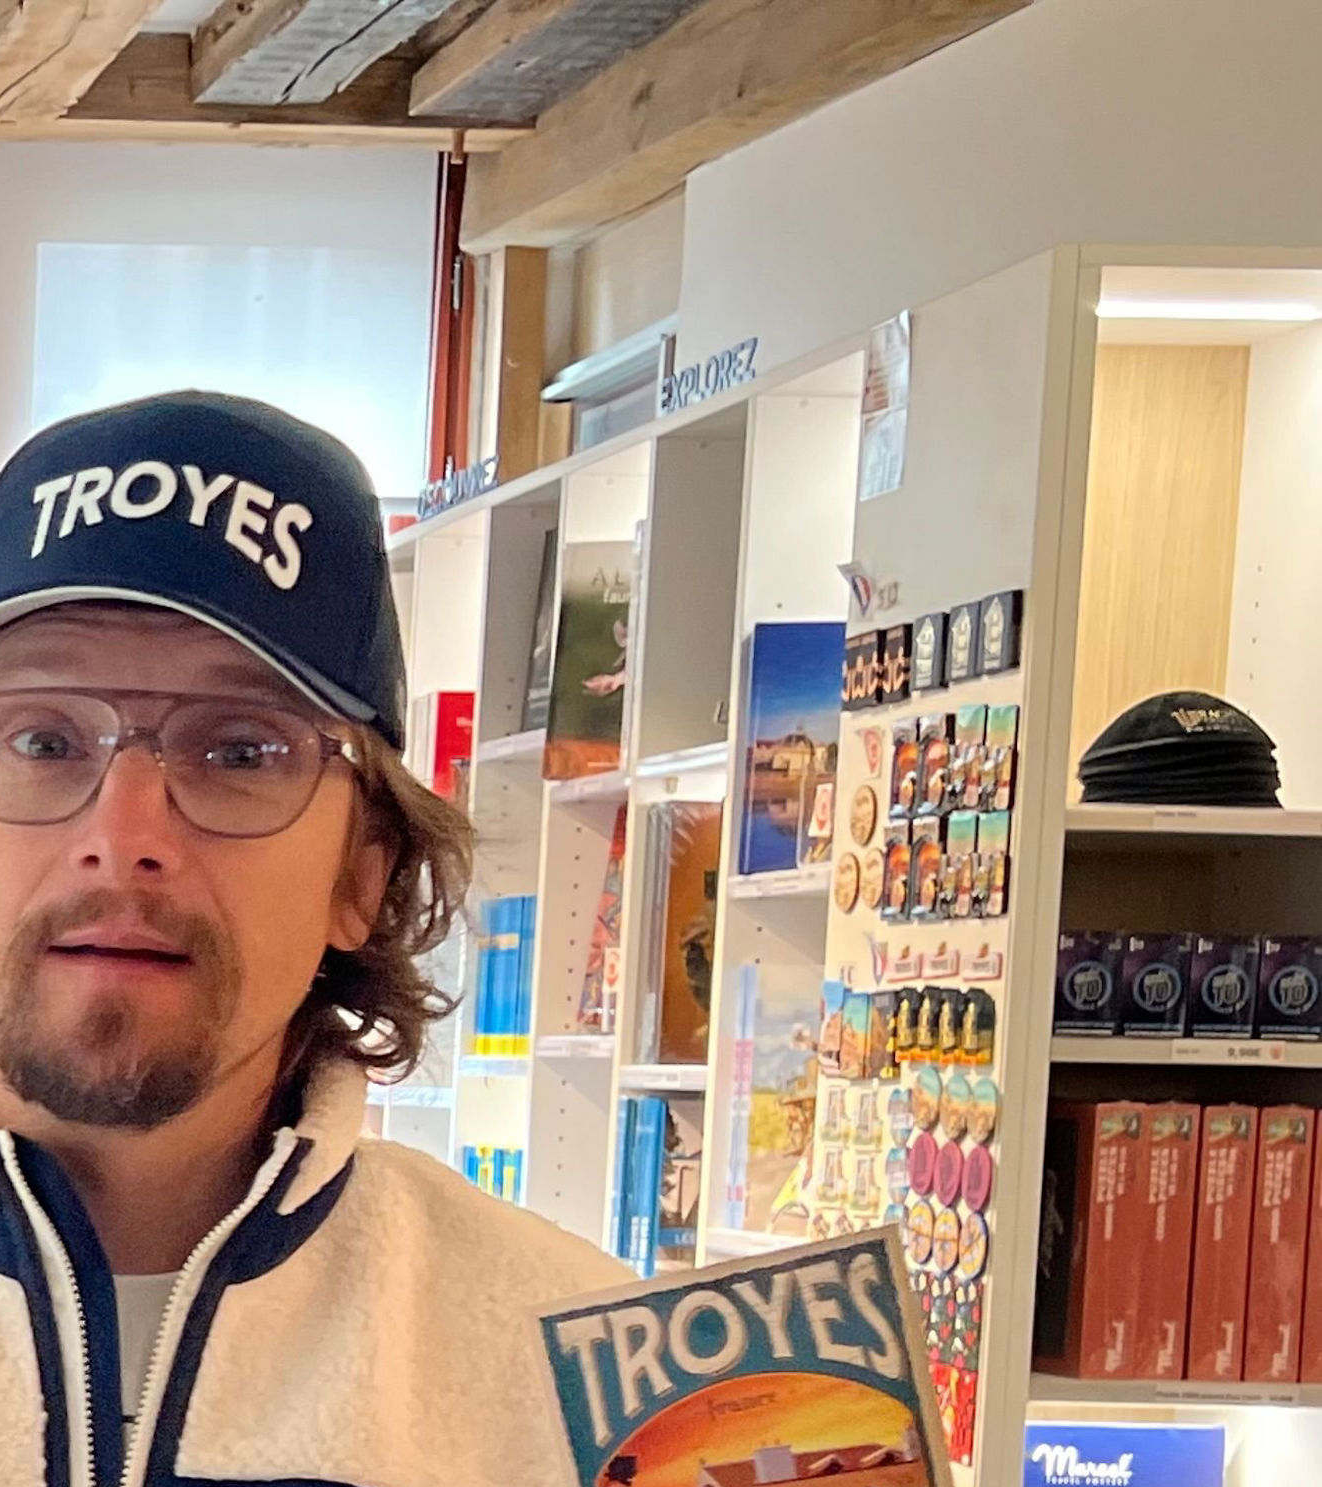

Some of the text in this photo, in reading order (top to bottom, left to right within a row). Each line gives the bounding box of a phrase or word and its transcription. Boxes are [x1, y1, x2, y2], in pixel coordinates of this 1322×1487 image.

[661, 337, 758, 413] EXPLOREZ
[30, 460, 313, 590] TROYES
[557, 1253, 906, 1447] TROYES
[1032, 1443, 1134, 1478] Marcel
